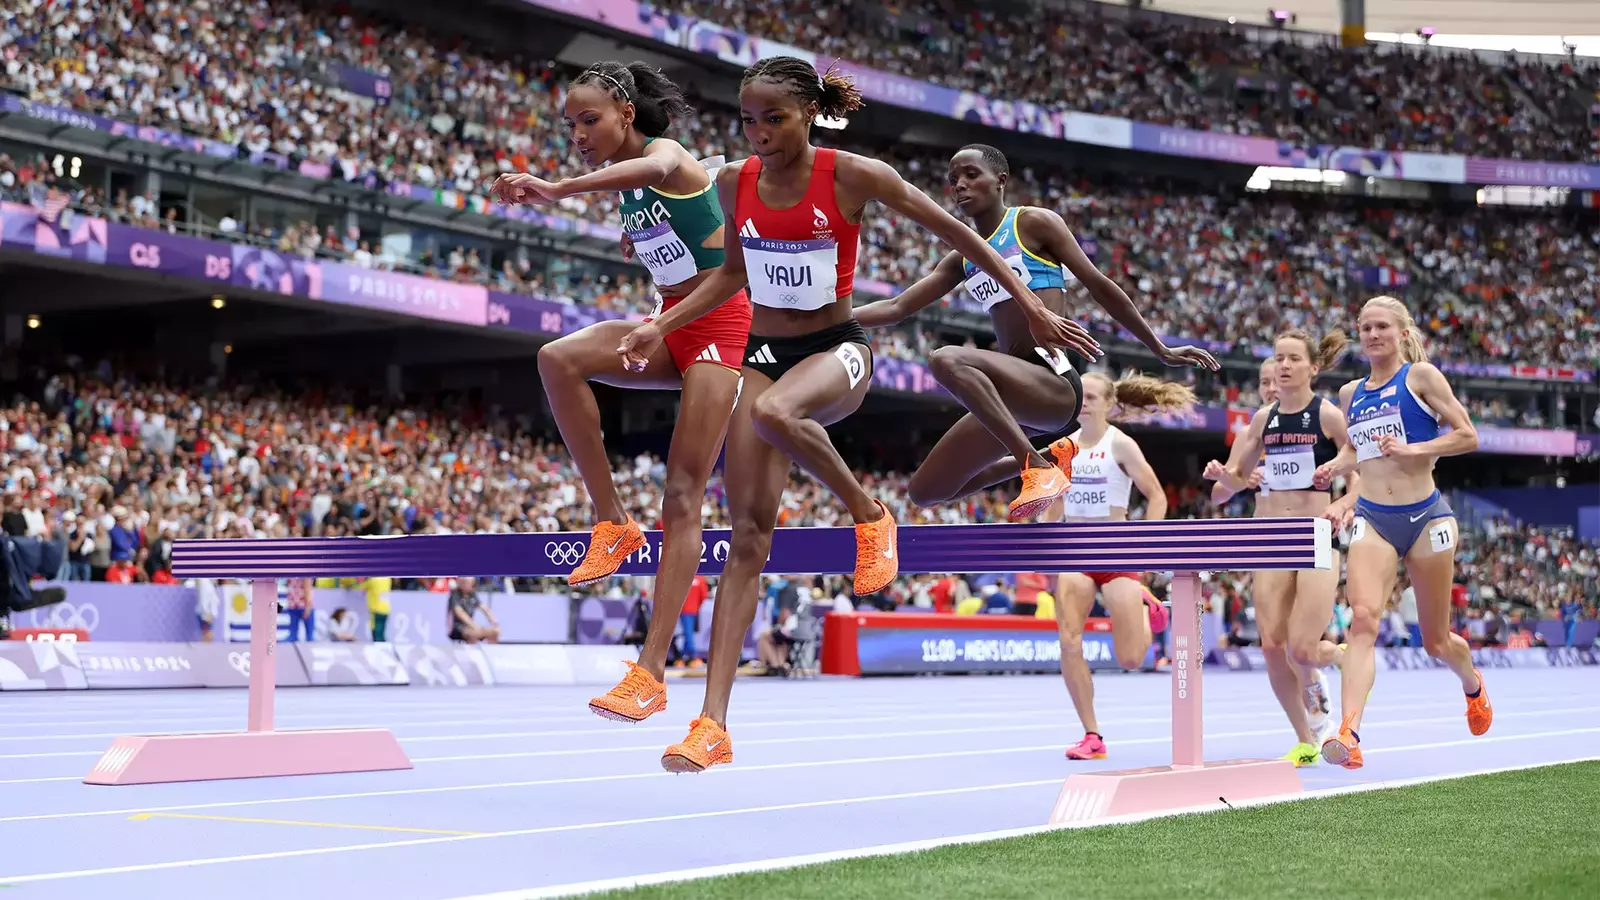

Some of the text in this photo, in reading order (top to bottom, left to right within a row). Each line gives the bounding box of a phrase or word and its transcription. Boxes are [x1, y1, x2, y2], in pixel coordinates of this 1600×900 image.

[760, 241, 808, 251] PARIS 2024
[205, 253, 231, 280] D5
[764, 262, 812, 287] YAVI
[349, 273, 462, 311] PARIS 2024
[1282, 432, 1319, 444] BRITAIN
[1072, 464, 1102, 475] NADA
[1272, 461, 1300, 476] BIRD
[1437, 529, 1451, 545] 11
[921, 639, 956, 662] 11:00
[1001, 639, 1035, 662] LONG
[1035, 640, 1061, 662] JUM
[1176, 650, 1188, 699] MONDO
